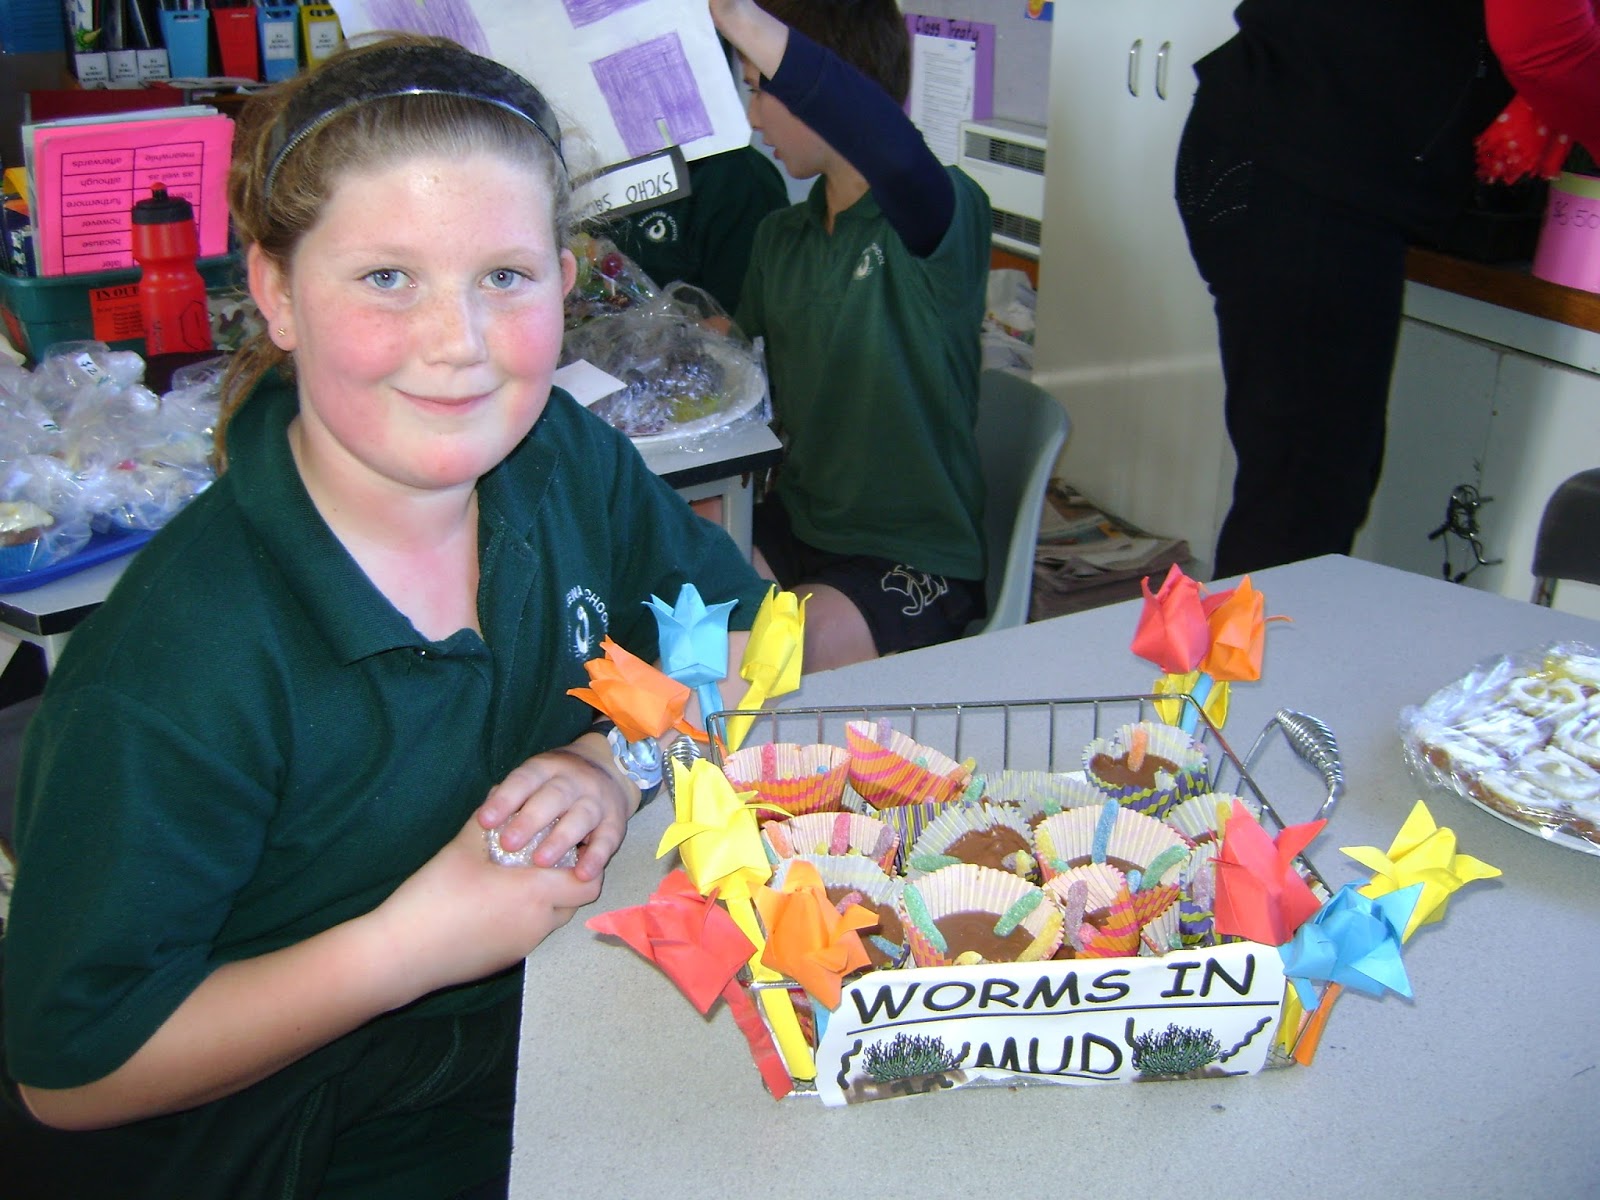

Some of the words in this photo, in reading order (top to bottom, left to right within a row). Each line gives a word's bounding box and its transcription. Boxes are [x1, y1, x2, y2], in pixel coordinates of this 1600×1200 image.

[916, 15, 940, 36] Class
[72, 157, 122, 168] afterwards
[145, 152, 194, 162] meanwhile
[80, 177, 121, 187] although
[66, 197, 121, 208] furthermore
[81, 218, 121, 227] however
[82, 238, 121, 248] because
[96, 290, 111, 301] IN
[850, 969, 1131, 1025] WORMS
[1159, 953, 1255, 998] IN
[973, 1031, 1123, 1074] MUD
